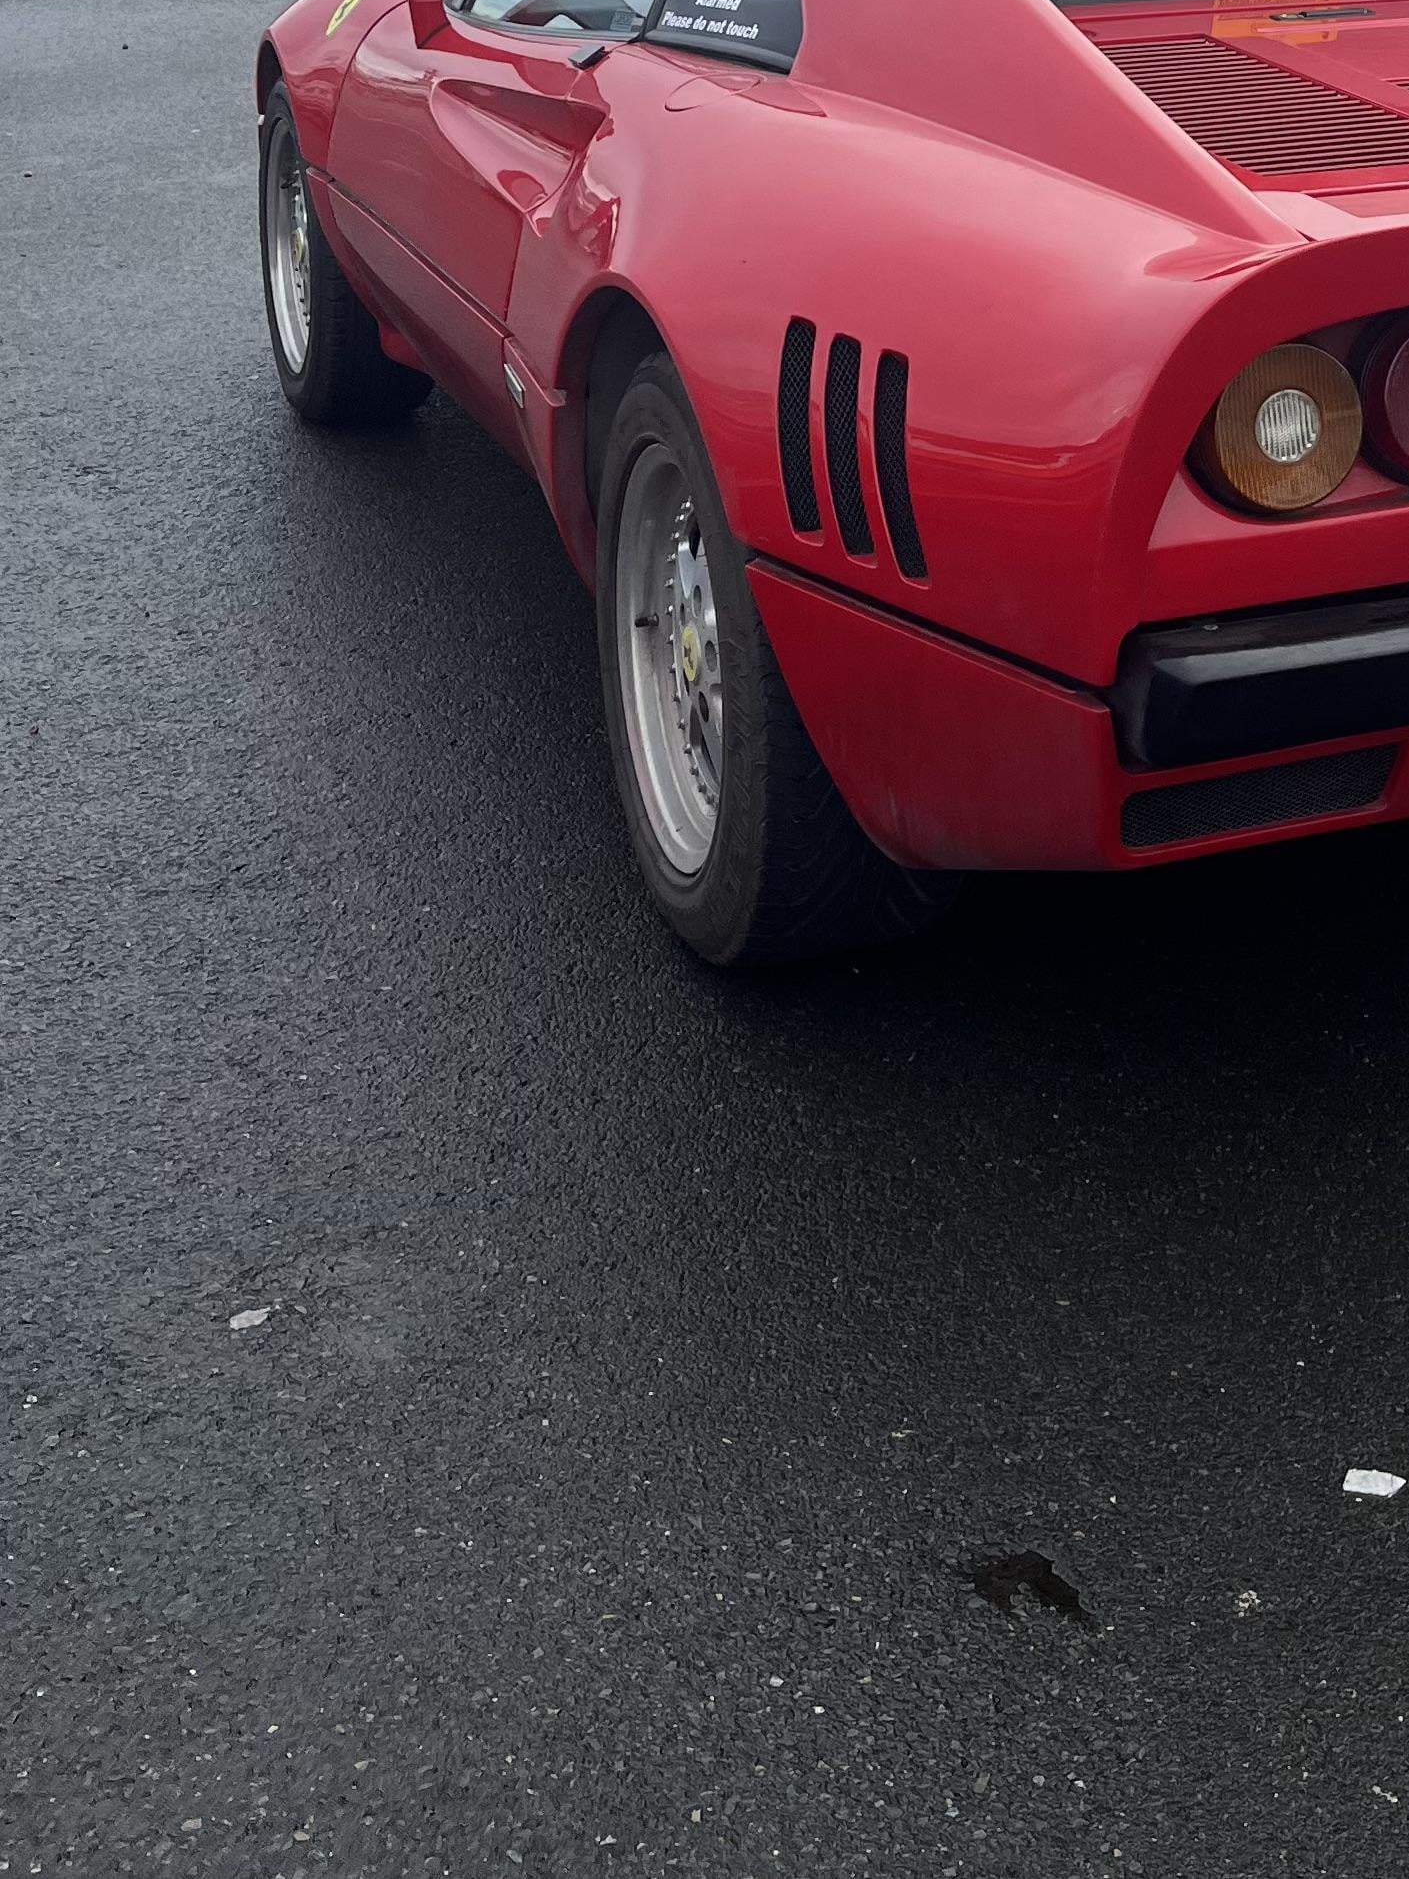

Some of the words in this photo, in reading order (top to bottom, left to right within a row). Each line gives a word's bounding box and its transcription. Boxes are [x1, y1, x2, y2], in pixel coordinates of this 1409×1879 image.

[661, 11, 693, 29] Please
[693, 15, 707, 30] do
[706, 20, 727, 34] not
[725, 21, 759, 39] touch
